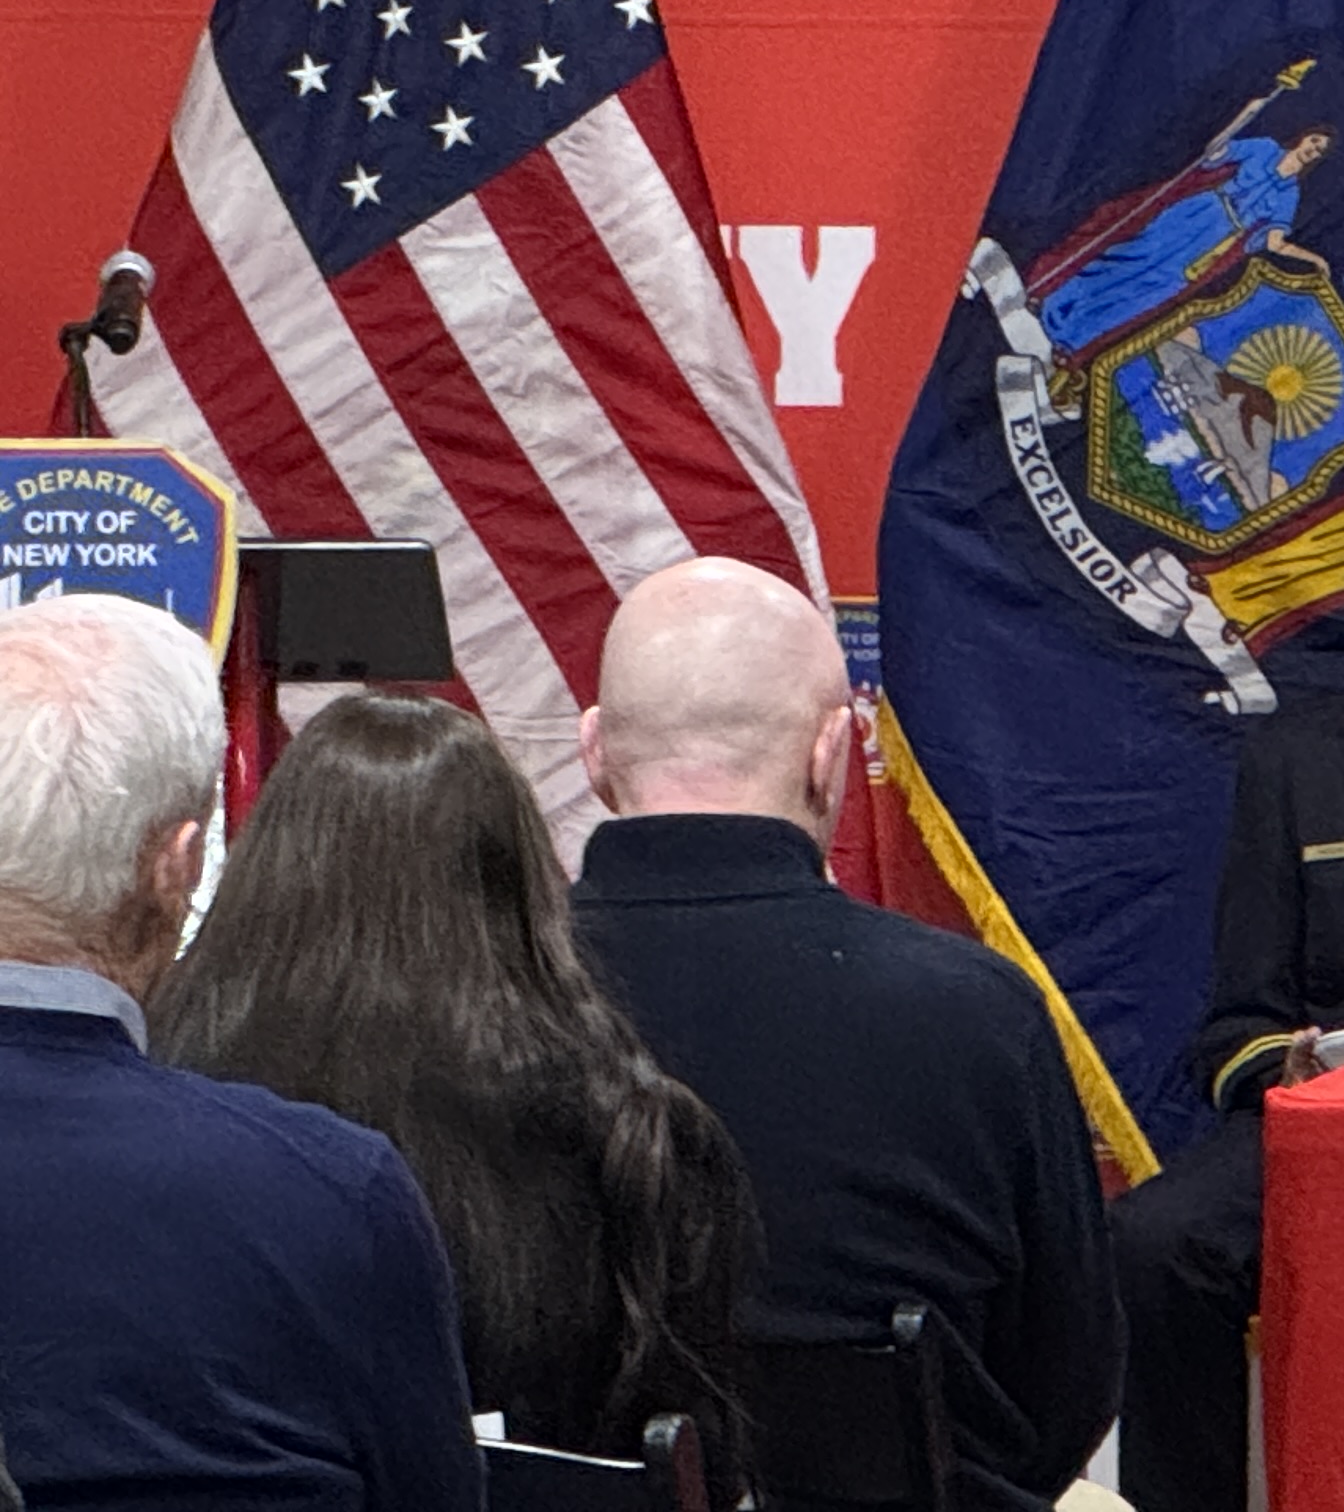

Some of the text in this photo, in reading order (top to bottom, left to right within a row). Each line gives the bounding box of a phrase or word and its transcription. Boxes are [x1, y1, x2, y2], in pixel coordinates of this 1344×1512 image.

[15, 467, 199, 546] DEPARTMENT
[23, 510, 138, 536] CITY OF
[1009, 413, 1138, 605] EXCELSIOR
[2, 542, 158, 568] NEW YORK
